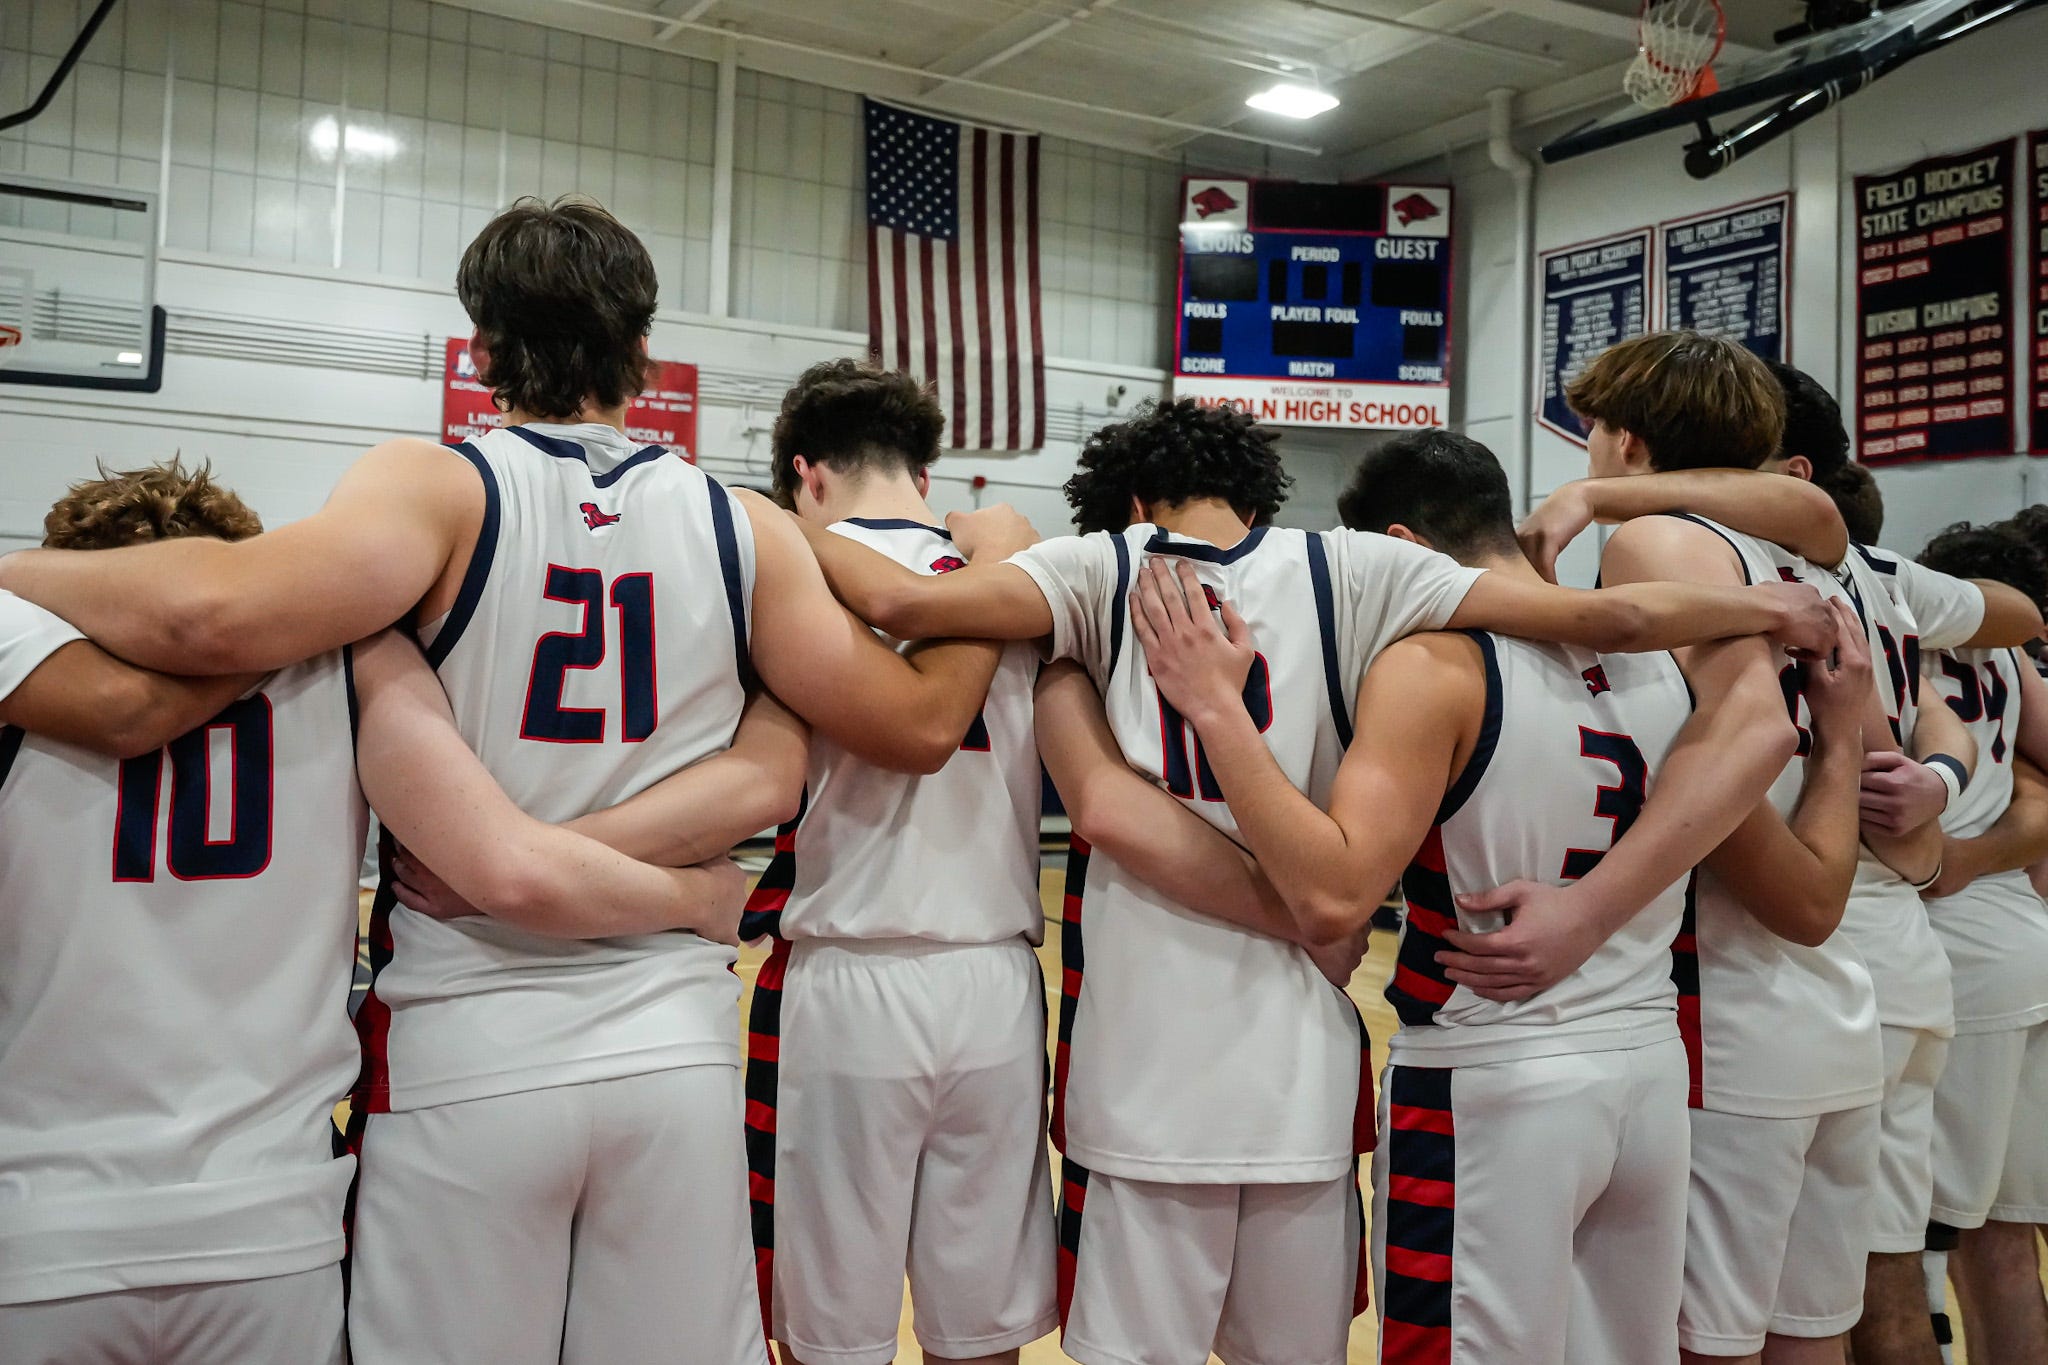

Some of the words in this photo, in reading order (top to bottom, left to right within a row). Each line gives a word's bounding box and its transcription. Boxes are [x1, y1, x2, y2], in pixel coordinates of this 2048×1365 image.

[1866, 177, 1917, 209] FIELD
[1924, 155, 2000, 195] HOCKEY
[1861, 207, 1909, 239] STATE
[1915, 185, 2004, 227] CHAMPIONS
[1198, 232, 1254, 254] LIONS
[1375, 238, 1440, 260] GUEST
[1291, 246, 1340, 262] PERIOD
[1184, 303, 1227, 319] FOULS
[1271, 306, 1321, 323] PLAYER
[1325, 307, 1359, 324] FOUL
[1400, 311, 1443, 326] FOULS
[1866, 306, 1917, 337] DIVISION
[1923, 292, 1999, 327] CHAMPIONS
[1182, 357, 1225, 373] SCORE
[1289, 362, 1335, 377] MATCH
[1398, 366, 1442, 381] SCORE
[1270, 385, 1332, 398] WELCOME
[1337, 387, 1354, 398] TO
[468, 413, 502, 427] LINC
[1285, 402, 1341, 422] HIGH
[1349, 403, 1443, 426] SCHOOL
[519, 563, 658, 744] 21
[112, 692, 274, 882] 10
[1560, 725, 1648, 879] 3
